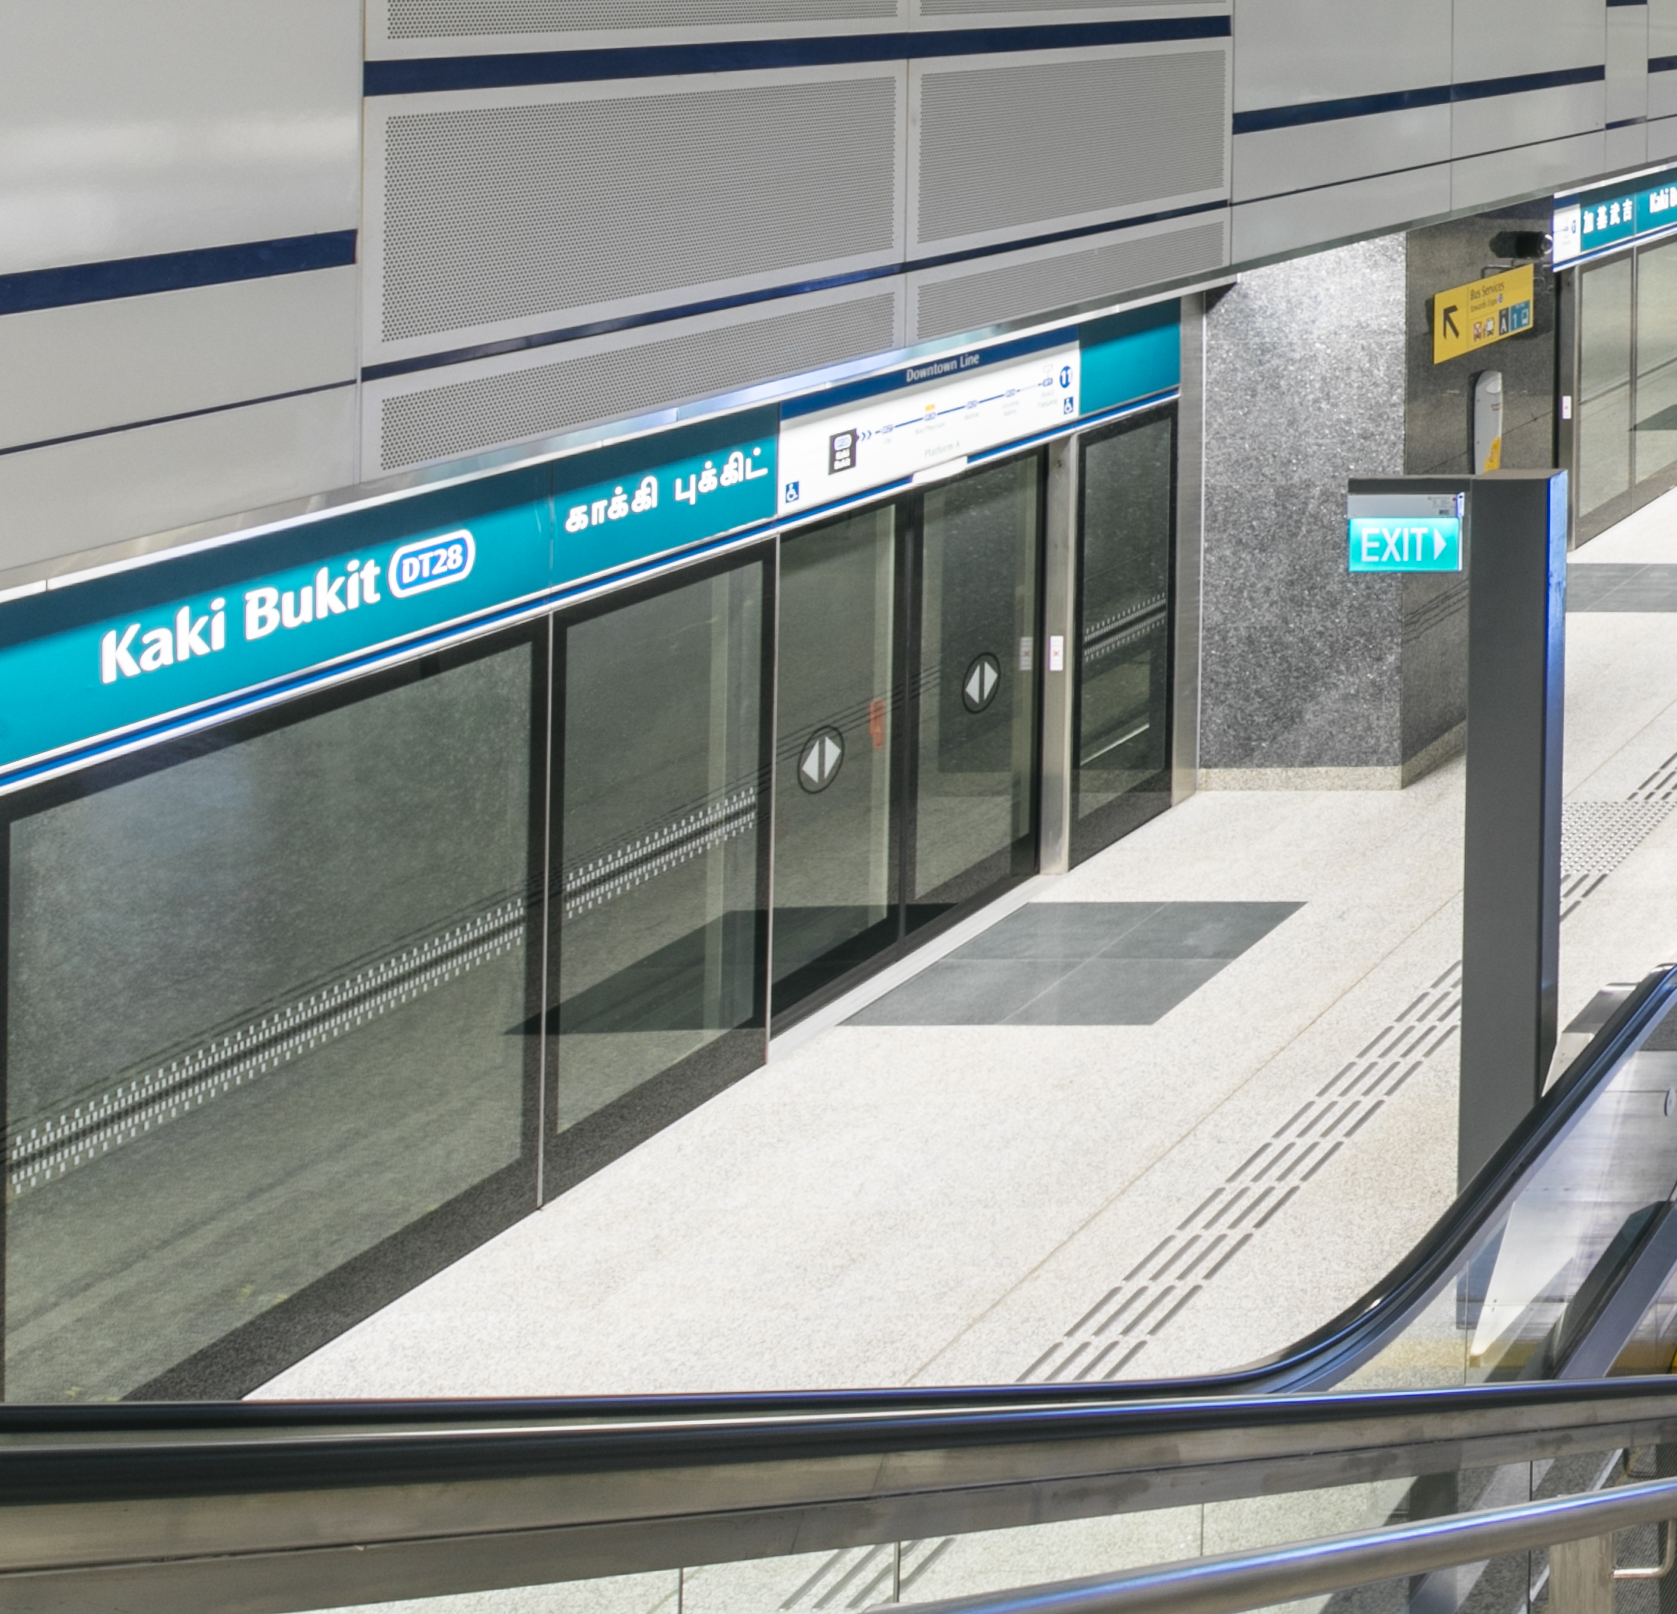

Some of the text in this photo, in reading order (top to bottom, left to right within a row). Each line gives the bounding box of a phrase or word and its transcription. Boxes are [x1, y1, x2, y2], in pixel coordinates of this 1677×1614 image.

[1470, 282, 1505, 300] Bus Services
[1500, 317, 1507, 334] A
[906, 353, 980, 383] Downtown Line
[1061, 369, 1071, 385] 11
[924, 443, 954, 458] Platform
[565, 476, 658, 532] காக்கி
[675, 447, 768, 505] புக்கிட்
[1362, 527, 1428, 562] EXIT
[102, 543, 463, 683] Kaki Bukit DT28
